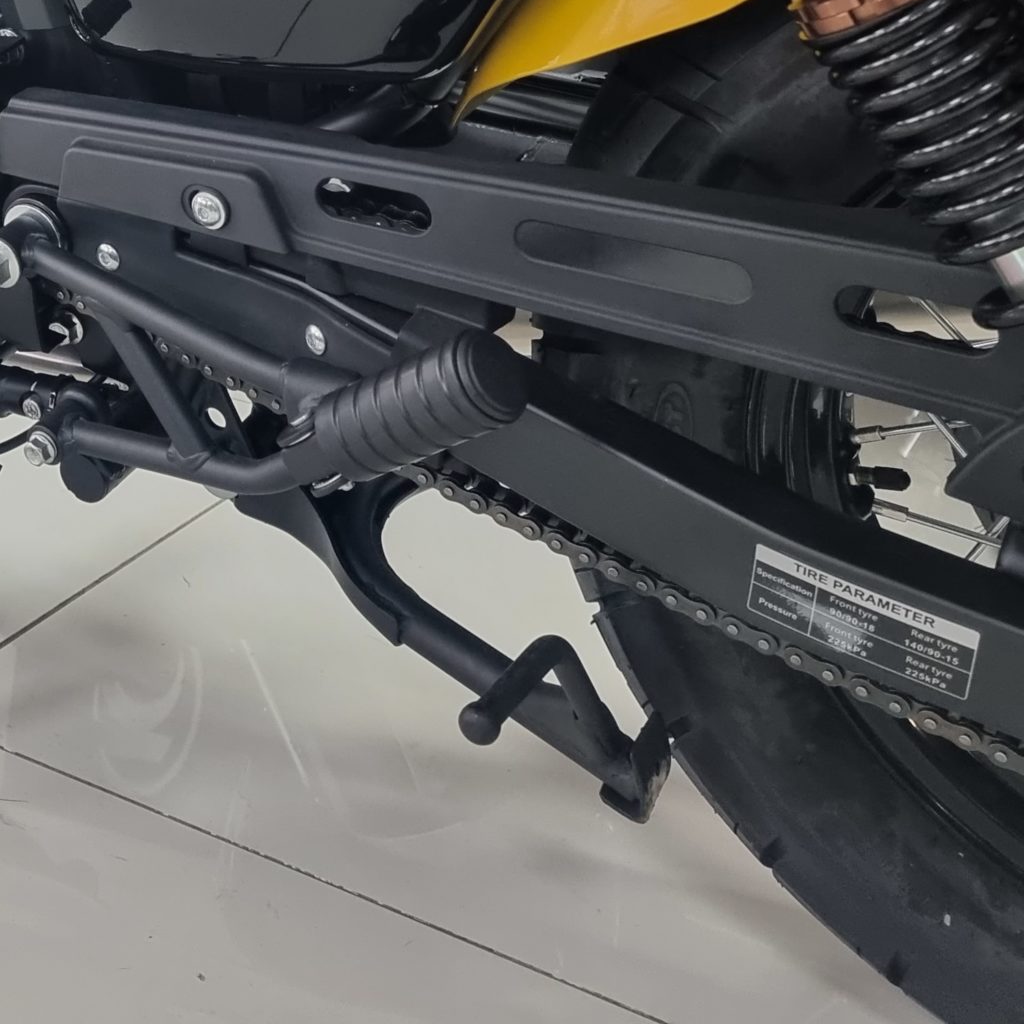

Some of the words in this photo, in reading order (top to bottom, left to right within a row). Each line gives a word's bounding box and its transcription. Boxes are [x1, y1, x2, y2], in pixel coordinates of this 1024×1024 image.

[756, 566, 813, 598] Specification
[794, 562, 830, 586] TIRE
[833, 579, 936, 629] PARAMETER
[758, 596, 799, 621] Pressure
[830, 596, 857, 613] Front
[858, 608, 879, 622] tyre
[825, 622, 852, 639] Front
[854, 634, 874, 648] tyre
[911, 629, 935, 644] Rear
[937, 639, 959, 653] tyre
[905, 656, 930, 671] Rear
[931, 666, 953, 680] tyre
[905, 667, 947, 689] 225kPa
